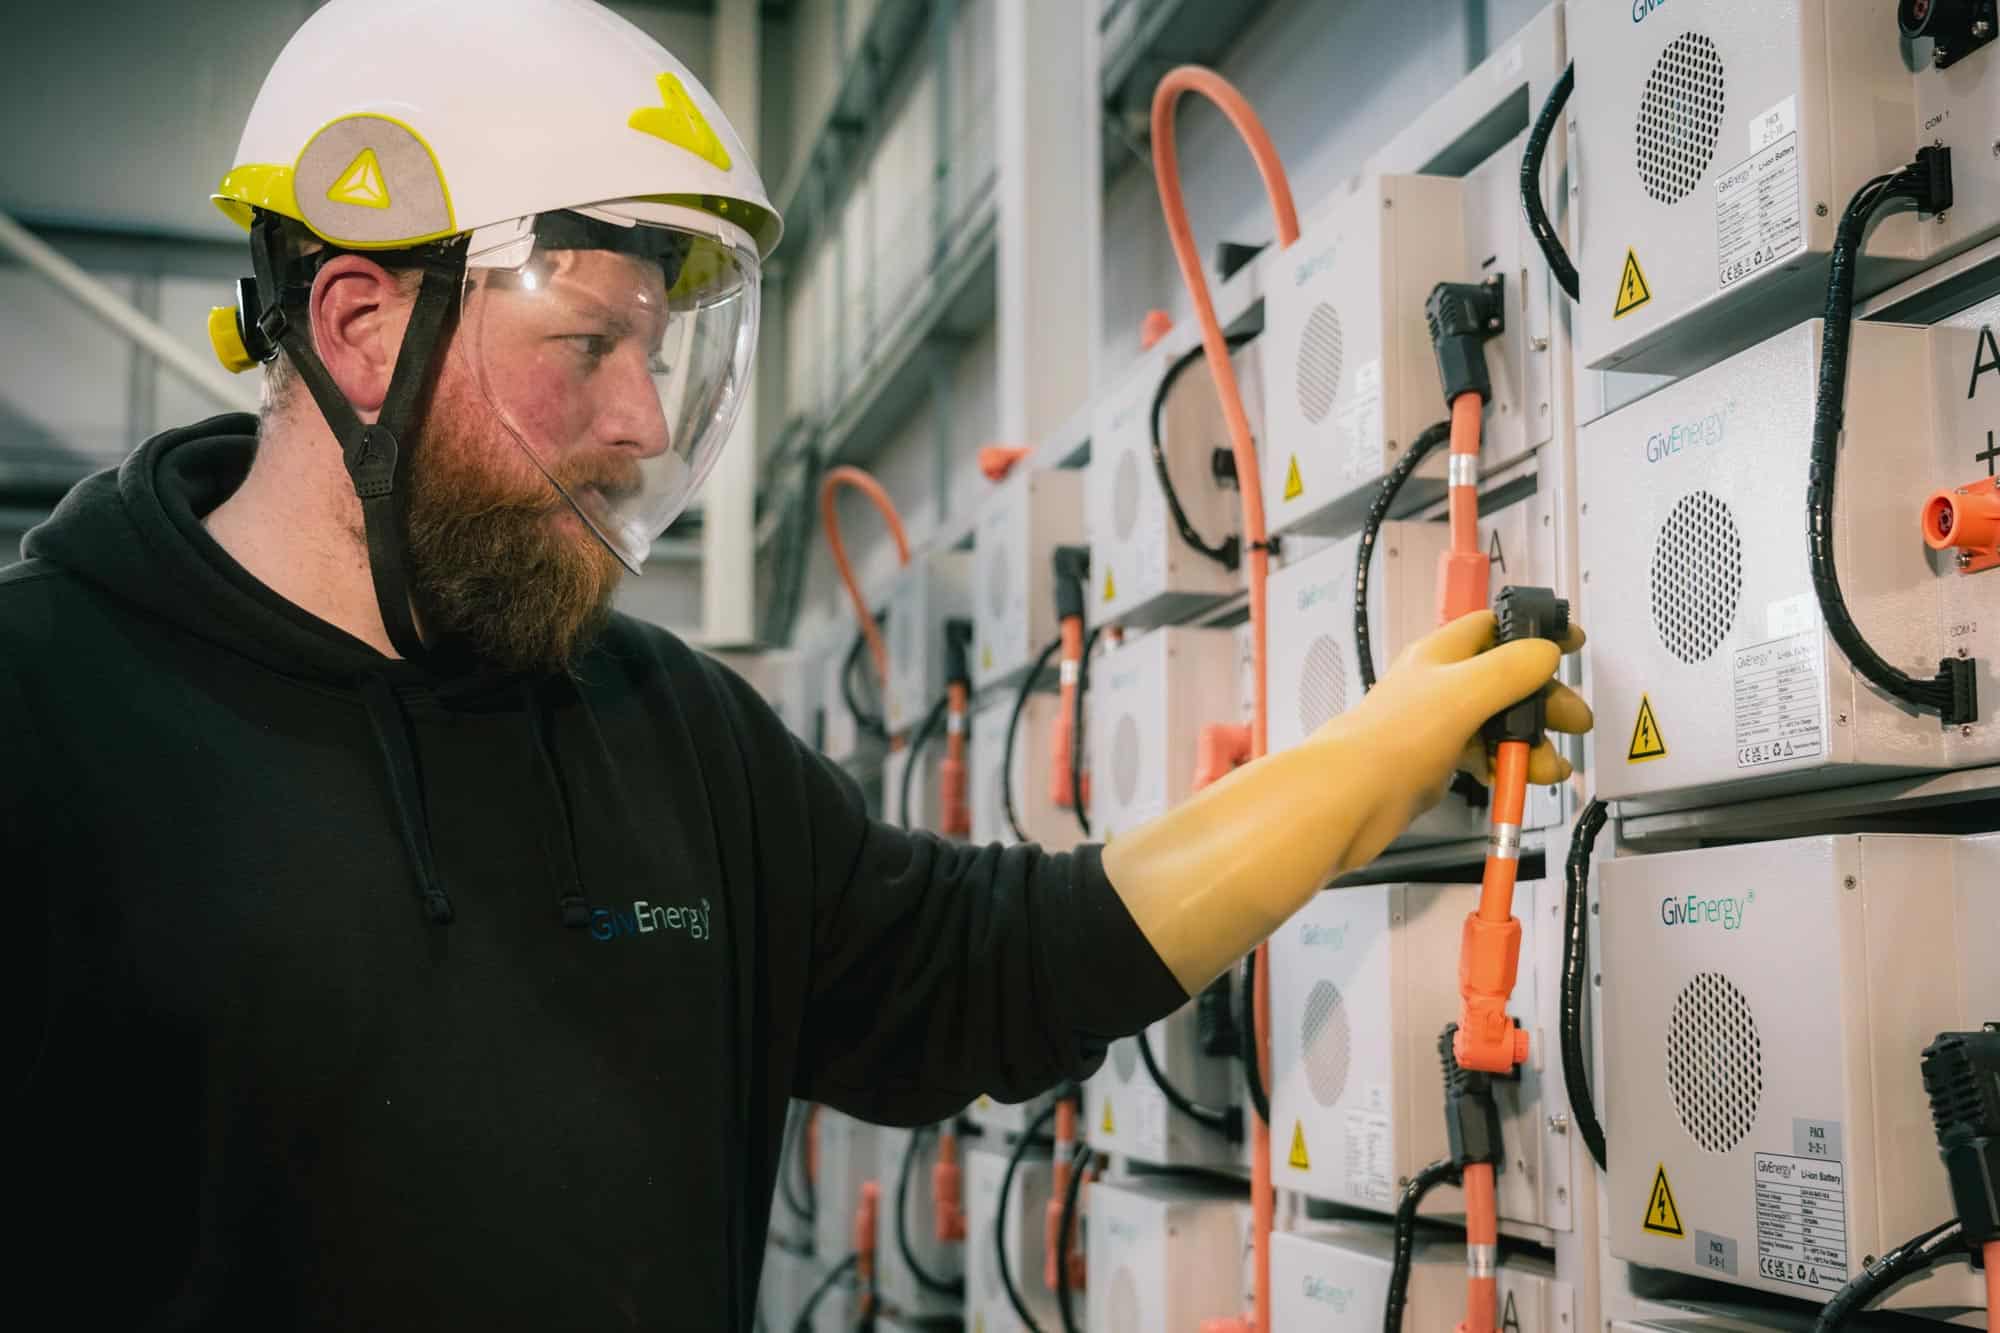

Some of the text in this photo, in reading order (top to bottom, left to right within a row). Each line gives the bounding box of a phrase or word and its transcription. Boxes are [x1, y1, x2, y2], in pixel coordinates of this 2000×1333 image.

[1632, 0, 1665, 23] Giv
[1925, 113, 1942, 130] COM
[1968, 324, 2000, 400] A
[1646, 410, 1725, 463] GivEnergy
[1488, 529, 1506, 574] A
[1951, 623, 1970, 638] COM
[592, 901, 710, 941] GivEnergy
[1661, 896, 1744, 930] GivEnergy
[1808, 1126, 1825, 1138] PACK
[1758, 1160, 1792, 1179] GivEnergy
[1819, 1172, 1841, 1184] Battery
[1502, 1289, 1520, 1333] A
